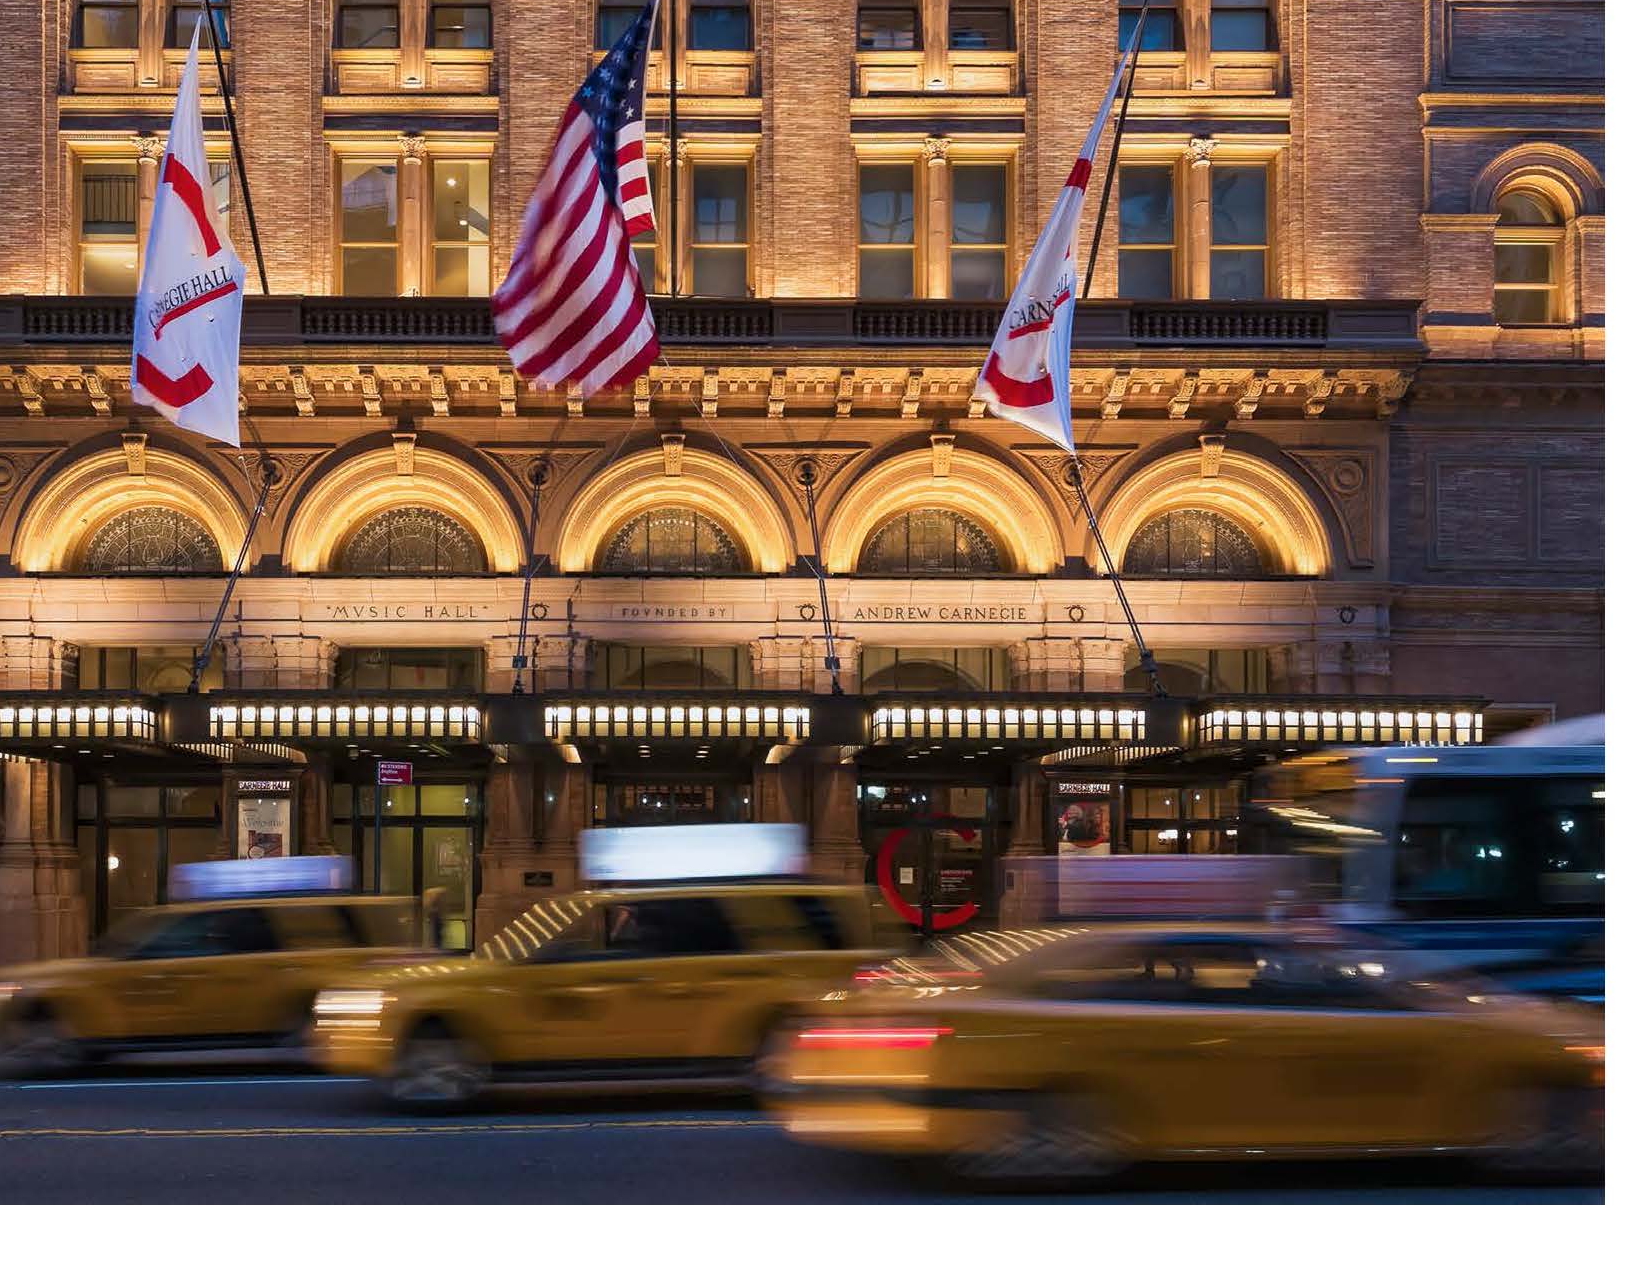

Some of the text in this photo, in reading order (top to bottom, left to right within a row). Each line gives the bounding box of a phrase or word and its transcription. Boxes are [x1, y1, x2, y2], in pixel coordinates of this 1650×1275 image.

[191, 265, 234, 297] HALL
[424, 605, 479, 618] HALL
[622, 607, 726, 617] FOVNDED BY
[854, 606, 1027, 620] ANDREW CARNEGIE
